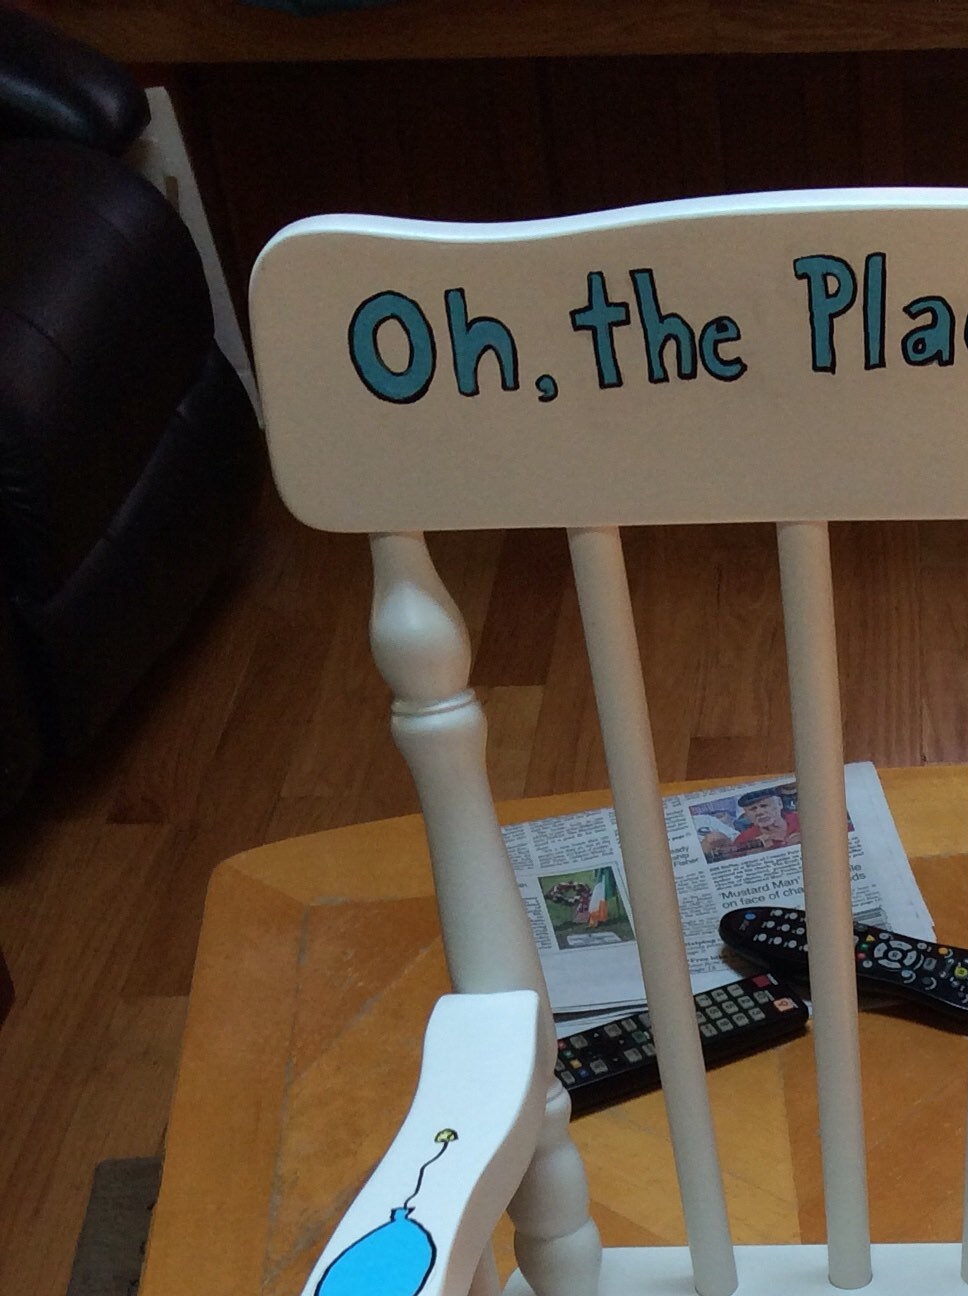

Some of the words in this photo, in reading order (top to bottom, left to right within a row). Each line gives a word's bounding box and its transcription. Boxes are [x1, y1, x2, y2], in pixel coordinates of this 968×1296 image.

[348, 288, 559, 404] Oh,
[569, 268, 747, 389] the
[722, 898, 738, 909] on
[739, 893, 766, 907] face
[768, 889, 781, 900] of
